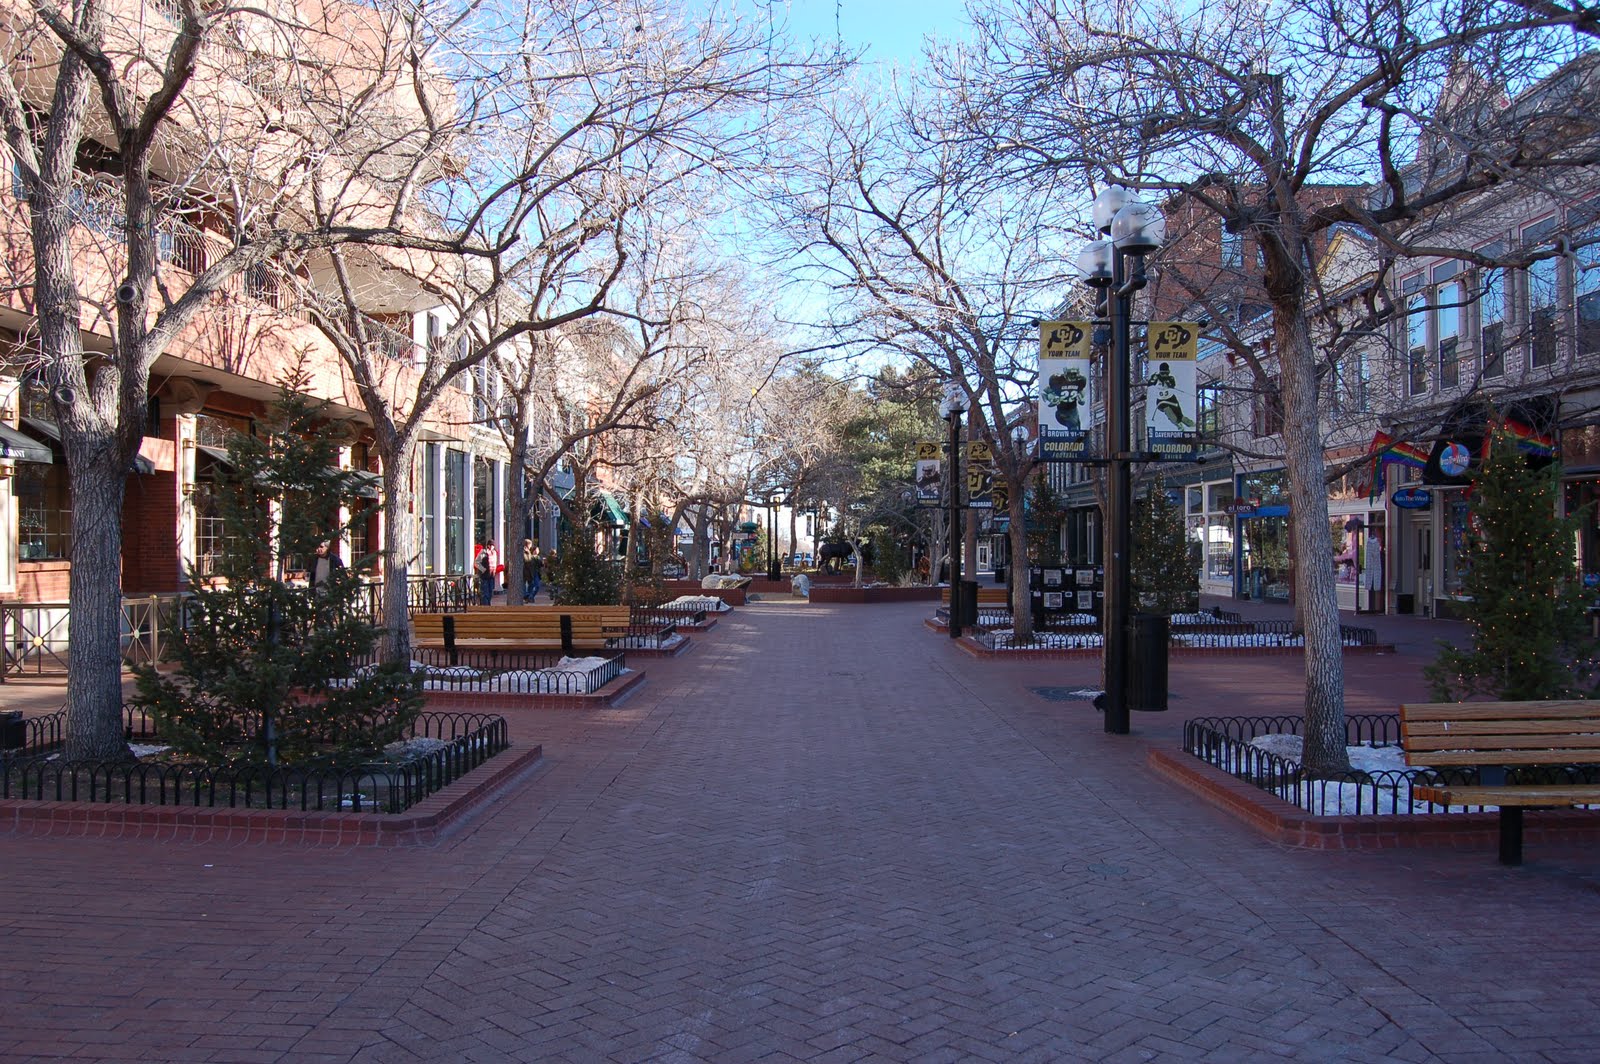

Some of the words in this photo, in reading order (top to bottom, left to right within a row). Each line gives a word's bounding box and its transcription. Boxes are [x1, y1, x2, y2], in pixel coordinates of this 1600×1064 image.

[1155, 351, 1170, 359] YOUR
[1172, 351, 1188, 359] TEAM
[1044, 442, 1085, 452] COLORADO
[1152, 443, 1192, 453] COLORADO
